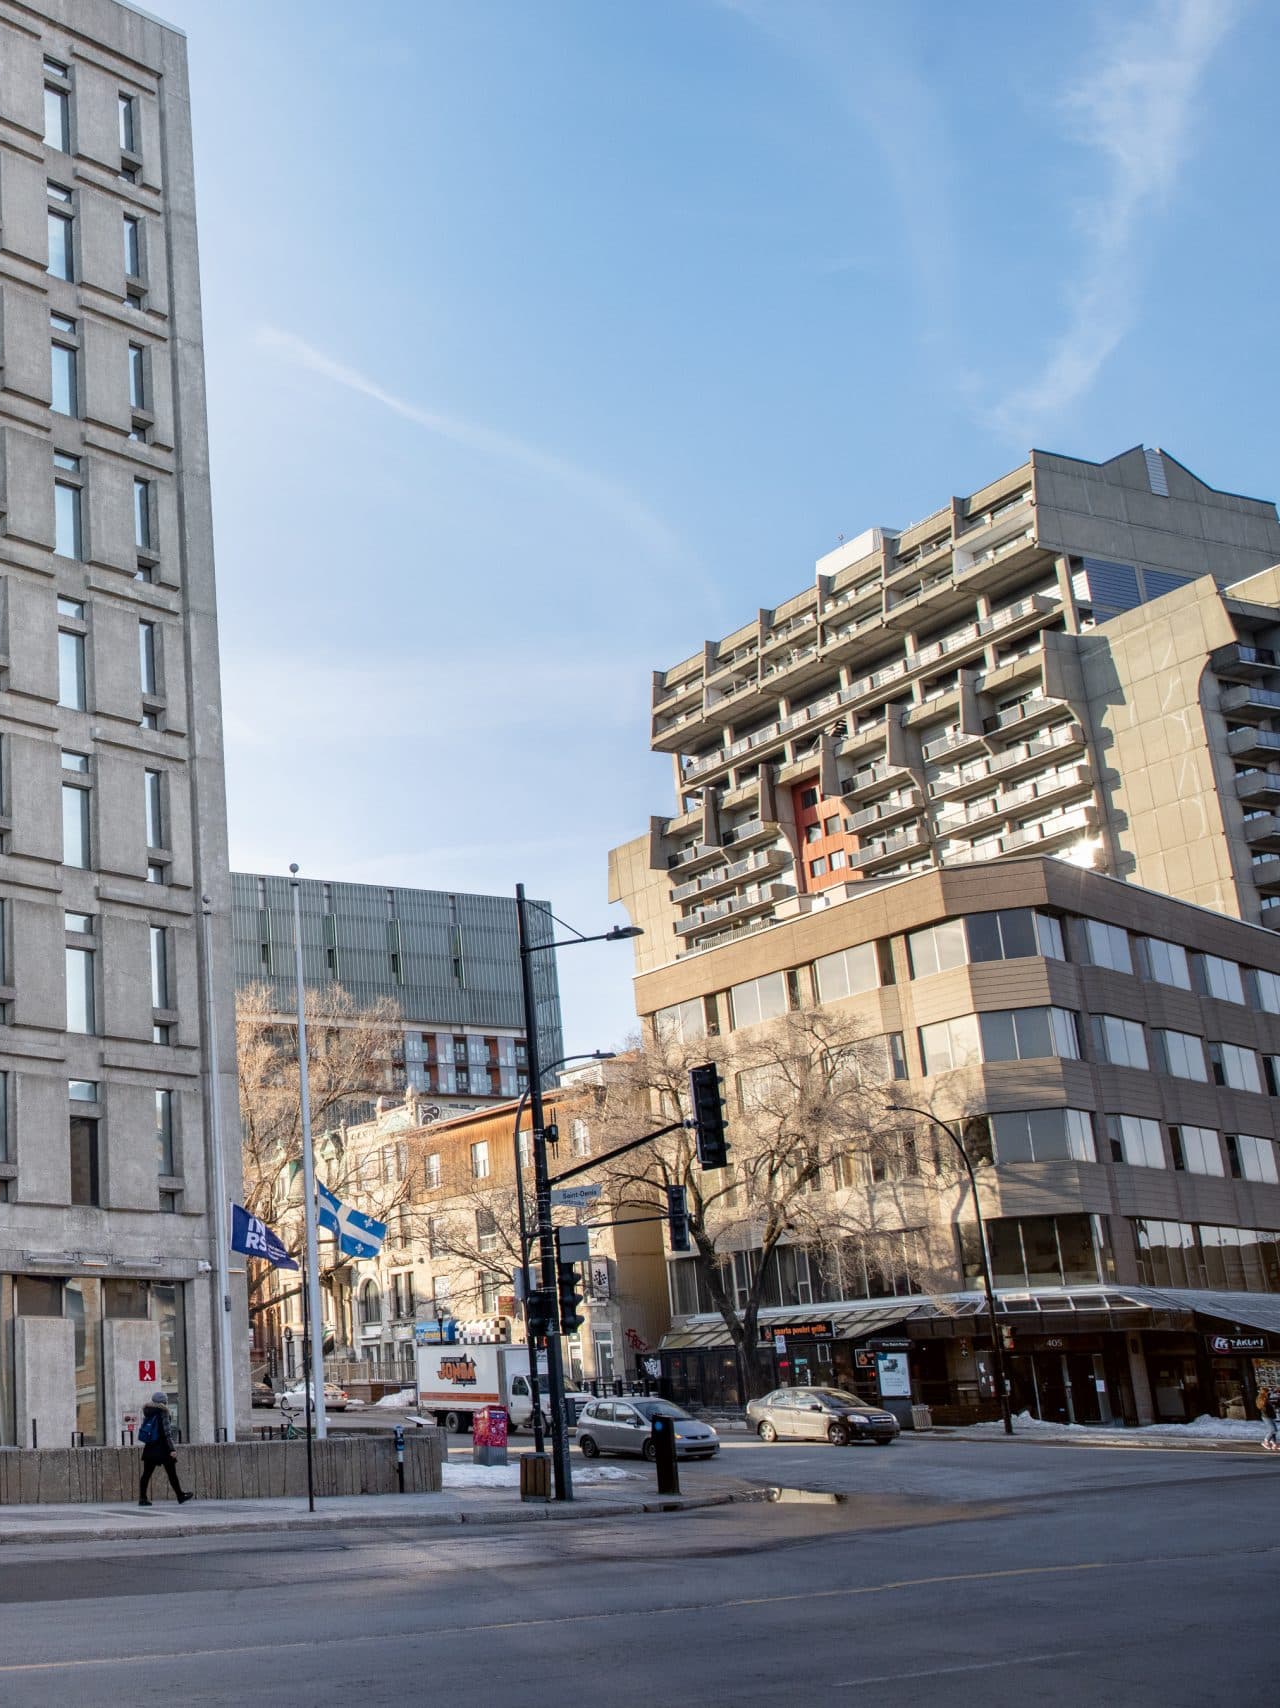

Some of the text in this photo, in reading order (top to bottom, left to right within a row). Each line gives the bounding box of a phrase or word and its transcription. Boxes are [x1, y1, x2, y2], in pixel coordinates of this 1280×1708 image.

[247, 1218, 266, 1236] IN
[245, 1232, 267, 1251] RS
[1230, 1338, 1264, 1346] TAKUMI
